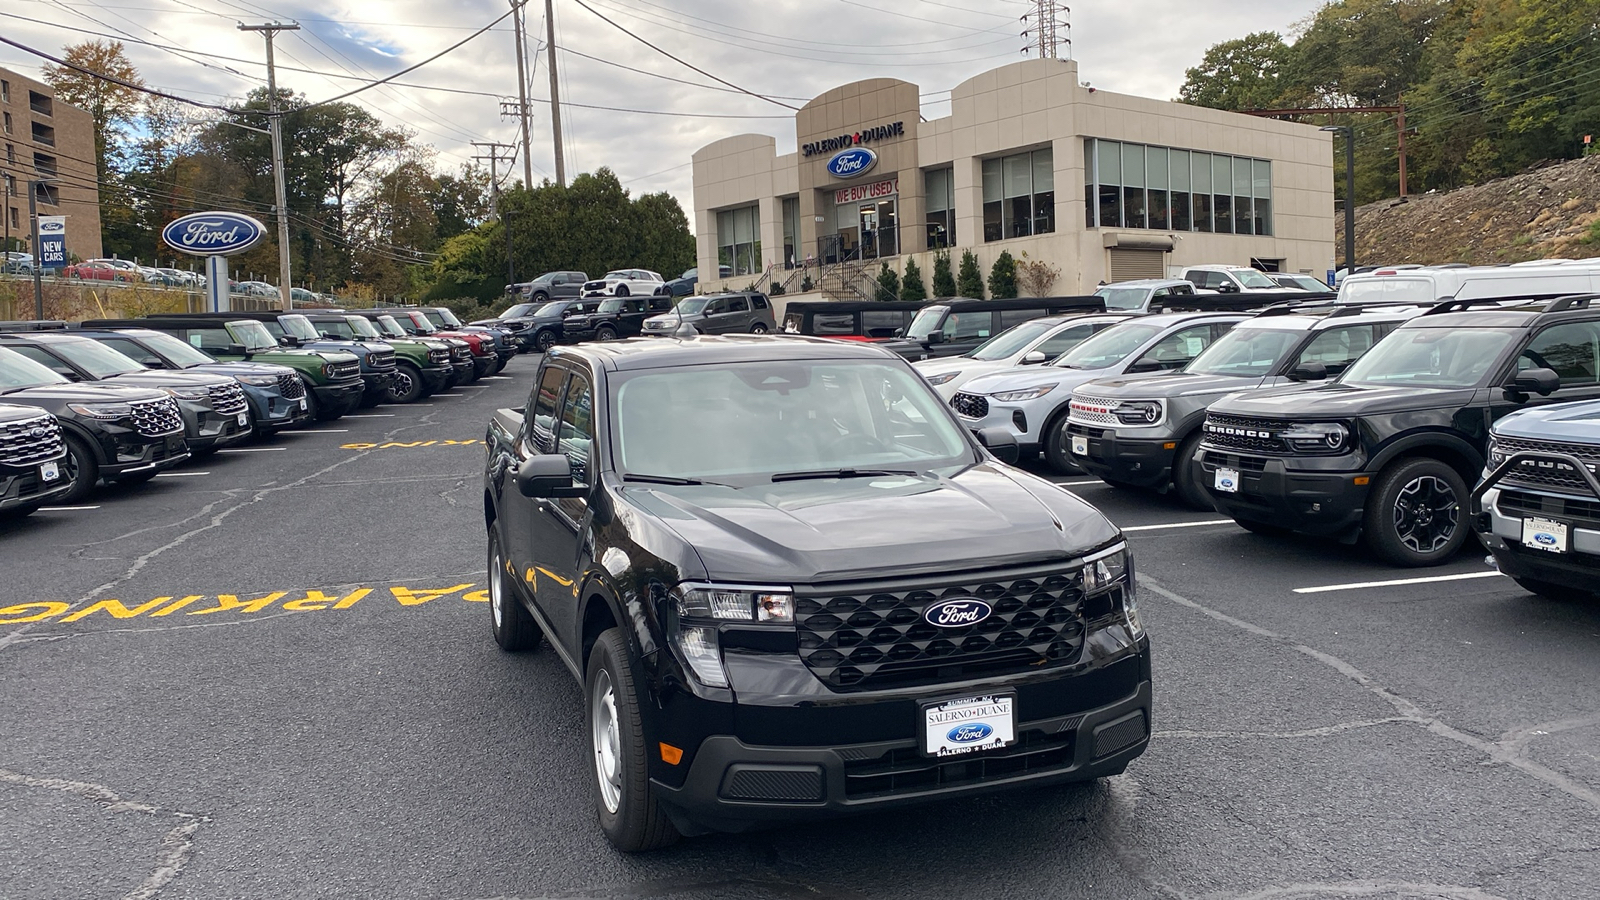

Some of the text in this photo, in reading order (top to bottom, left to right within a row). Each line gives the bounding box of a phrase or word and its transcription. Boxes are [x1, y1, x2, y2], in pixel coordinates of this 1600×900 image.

[802, 121, 905, 157] SALERNO DUANE
[836, 154, 863, 173] Ford
[836, 189, 849, 203] WE
[851, 185, 868, 200] BUY
[869, 181, 892, 197] USED
[182, 221, 239, 245] Ford
[43, 241, 62, 252] NEW
[44, 252, 64, 262] CARS
[1071, 404, 1107, 414] BRONCO
[1208, 425, 1270, 438] BRONCO
[938, 603, 980, 624] Ford
[929, 704, 1010, 724] SALERNO DUANE
[955, 726, 984, 740] Ford
[937, 741, 1007, 757] SALERNO DUANE
